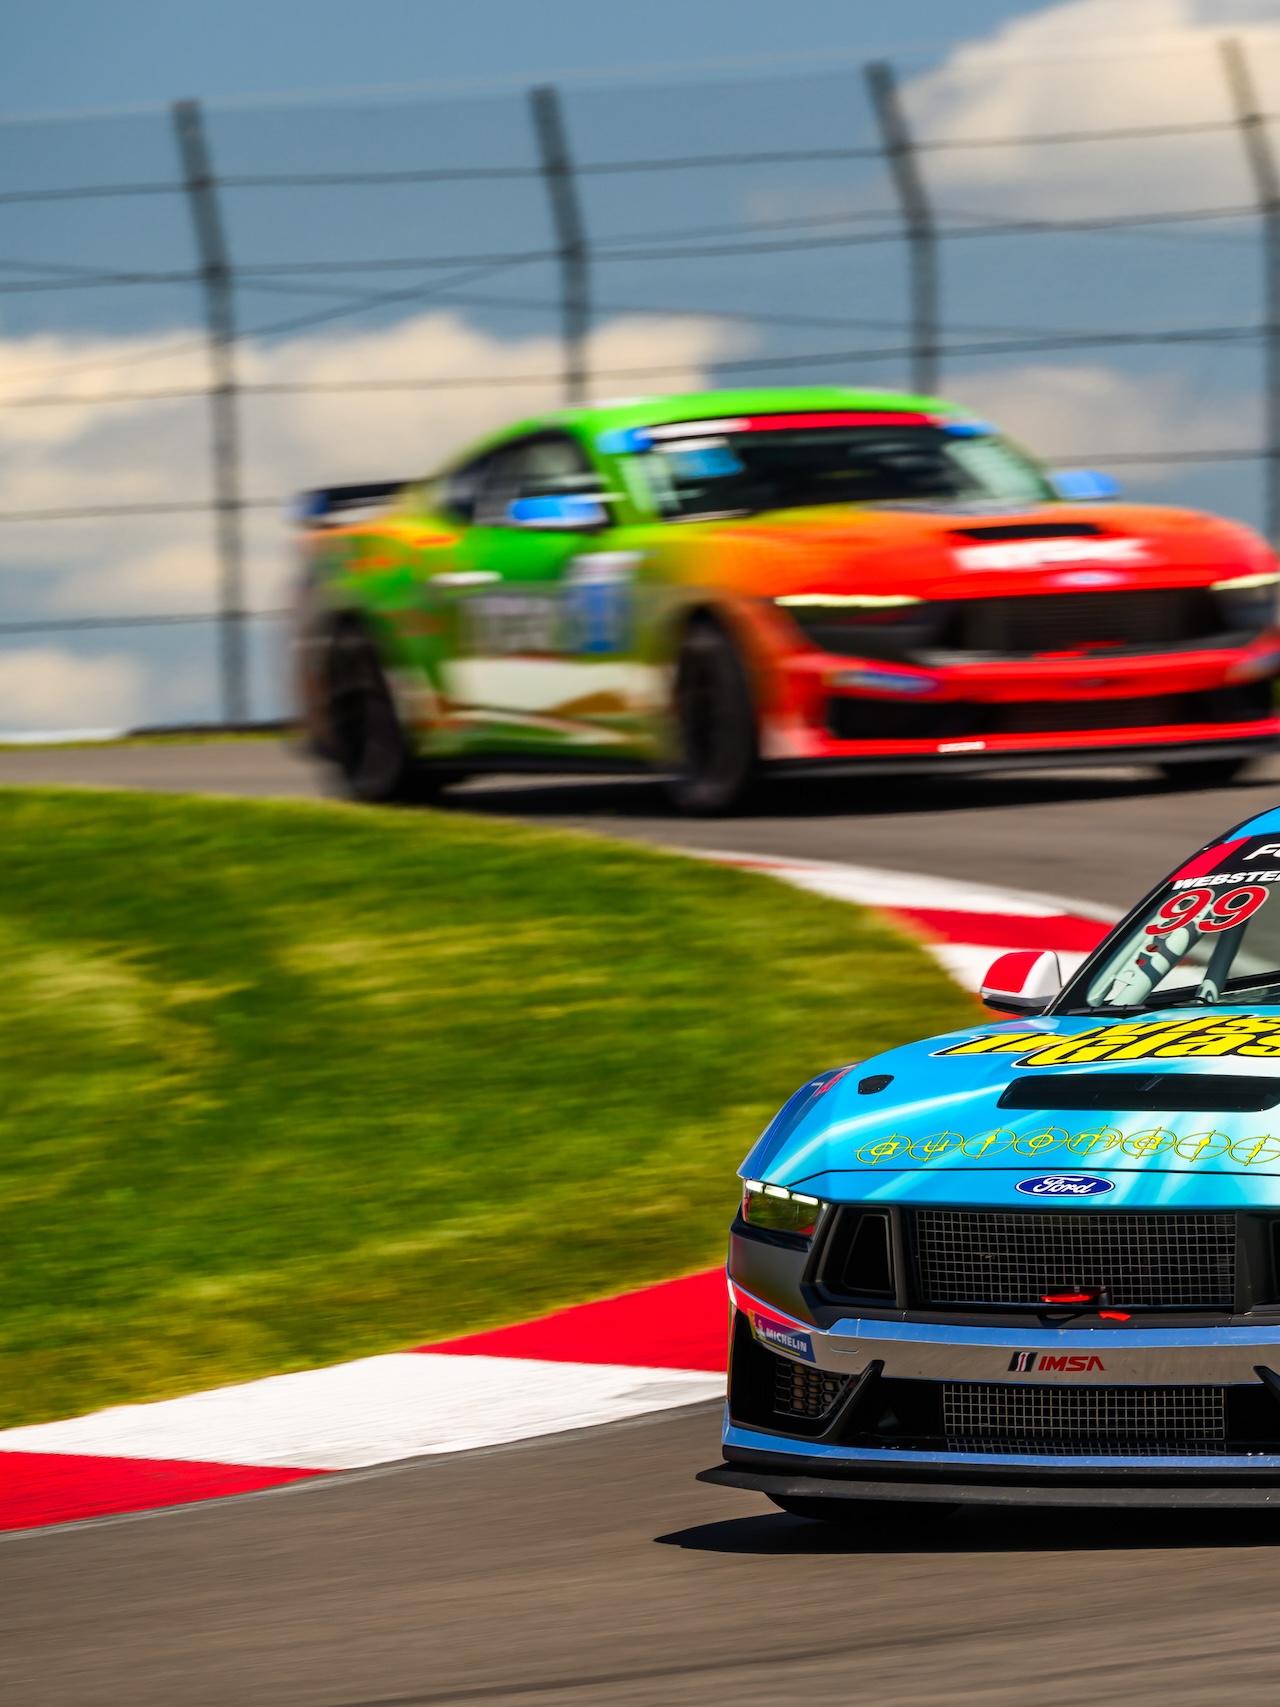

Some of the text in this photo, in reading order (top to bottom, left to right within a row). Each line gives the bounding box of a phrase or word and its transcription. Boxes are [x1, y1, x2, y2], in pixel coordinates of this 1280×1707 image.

[1145, 885, 1271, 936] 99
[1032, 1176, 1097, 1194] Ford
[766, 1327, 808, 1352] MICHELIN
[1038, 1356, 1105, 1371] IMSA
